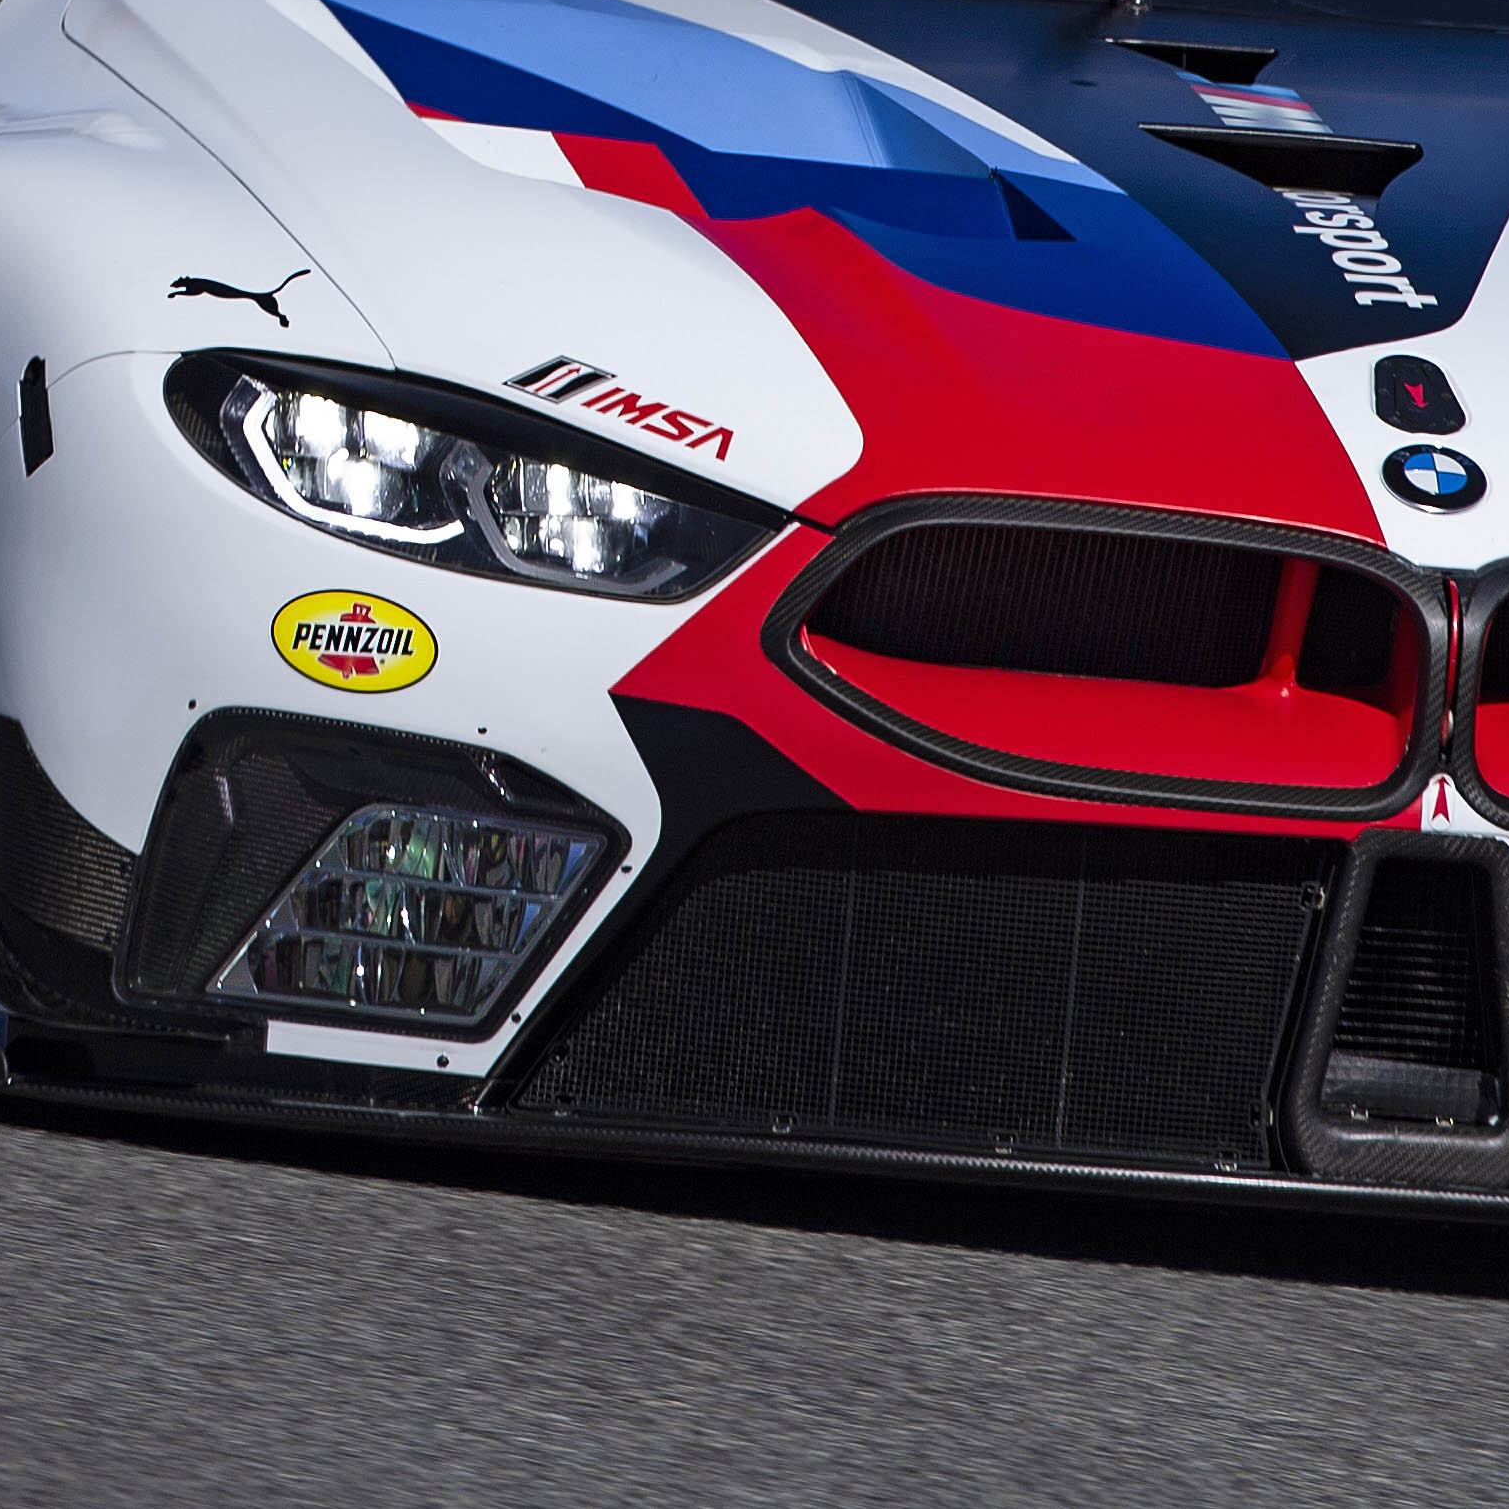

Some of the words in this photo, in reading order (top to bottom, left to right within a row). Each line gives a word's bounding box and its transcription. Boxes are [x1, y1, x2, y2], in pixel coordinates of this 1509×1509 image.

[1276, 188, 1439, 310] orsport
[580, 386, 735, 462] IMSA
[291, 621, 416, 659] PENNZOIL
